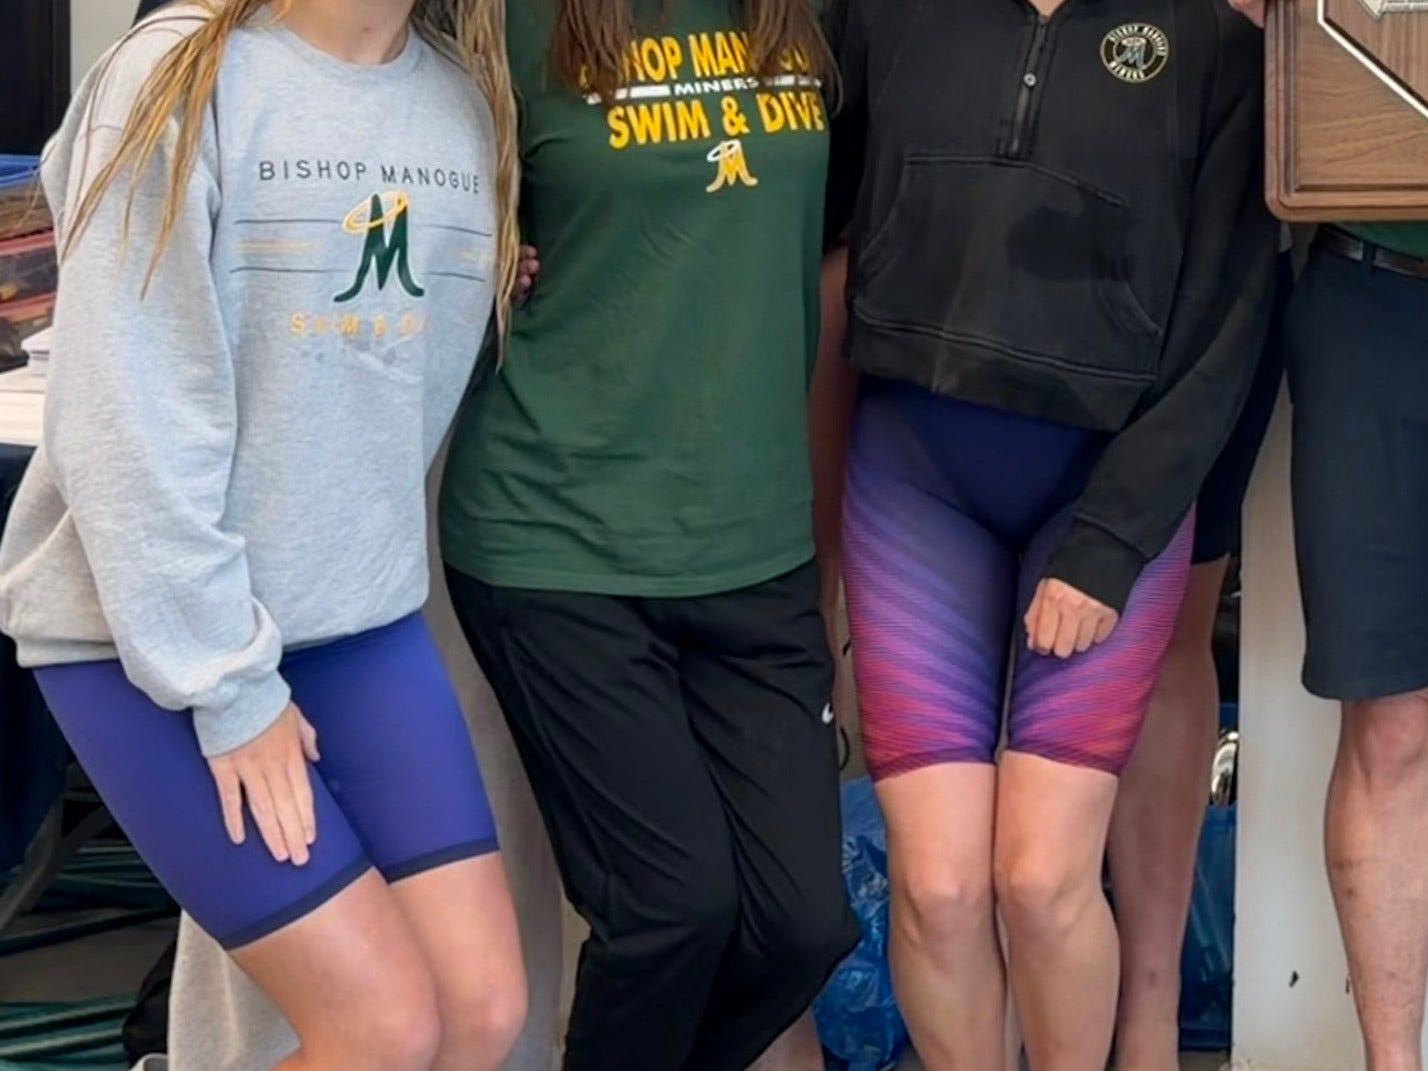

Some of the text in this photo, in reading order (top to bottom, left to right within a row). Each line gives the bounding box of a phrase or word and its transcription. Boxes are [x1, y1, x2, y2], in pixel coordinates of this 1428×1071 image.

[674, 77, 759, 97] MINERS
[607, 90, 825, 150] SWIM & DIVE
[258, 160, 480, 194] BISHOP MANOGUE
